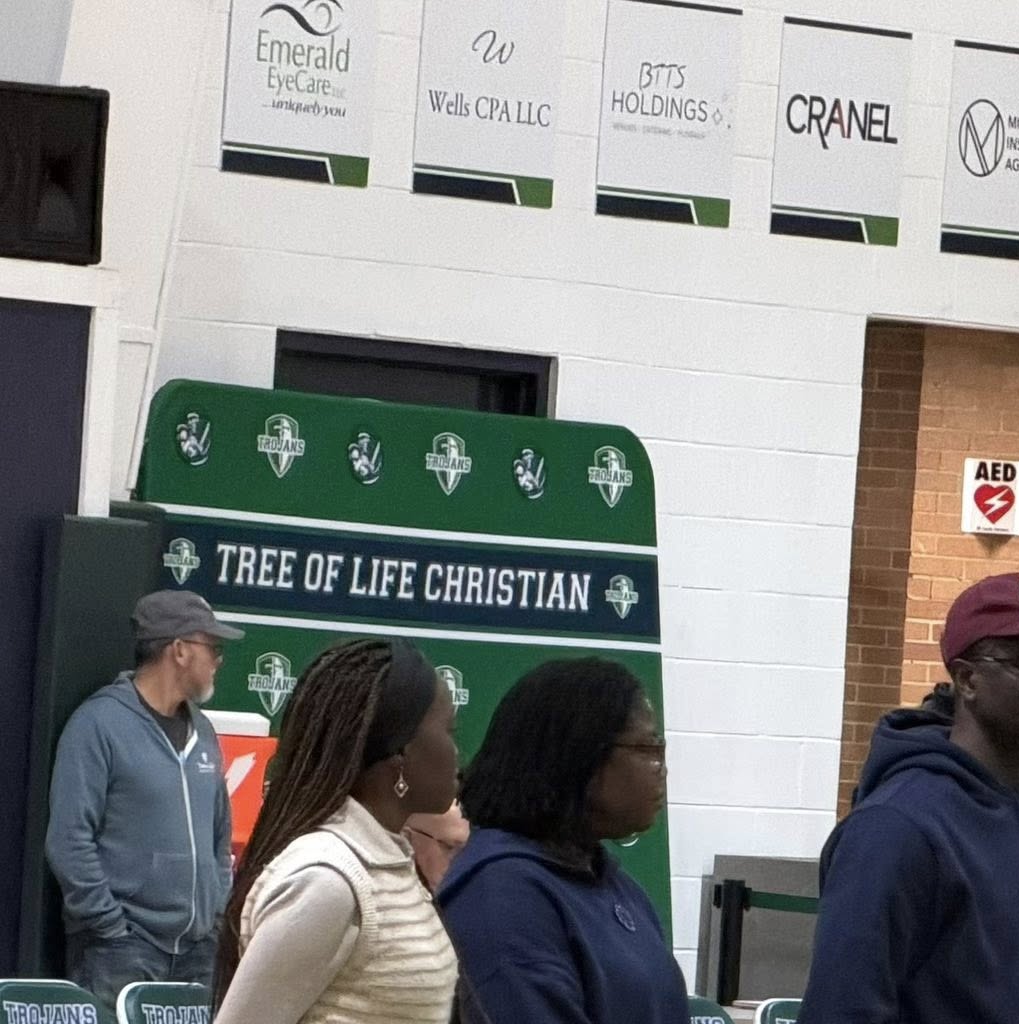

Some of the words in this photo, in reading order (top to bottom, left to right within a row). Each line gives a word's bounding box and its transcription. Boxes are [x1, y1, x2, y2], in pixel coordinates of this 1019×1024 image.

[257, 28, 350, 72] Emerald
[268, 66, 331, 96] EyeCare
[639, 61, 687, 90] BTTS
[429, 89, 471, 117] Wells
[475, 96, 511, 122] CPA
[516, 101, 551, 127] LLC
[611, 89, 708, 123] HOLDINGS
[786, 93, 898, 150] CRANEL
[257, 434, 305, 456] TROJANS
[974, 461, 1017, 482] AED
[216, 543, 297, 589] TREE
[303, 552, 344, 593] OF
[349, 556, 418, 600] LIFE
[424, 563, 592, 612] CHRISTIAN
